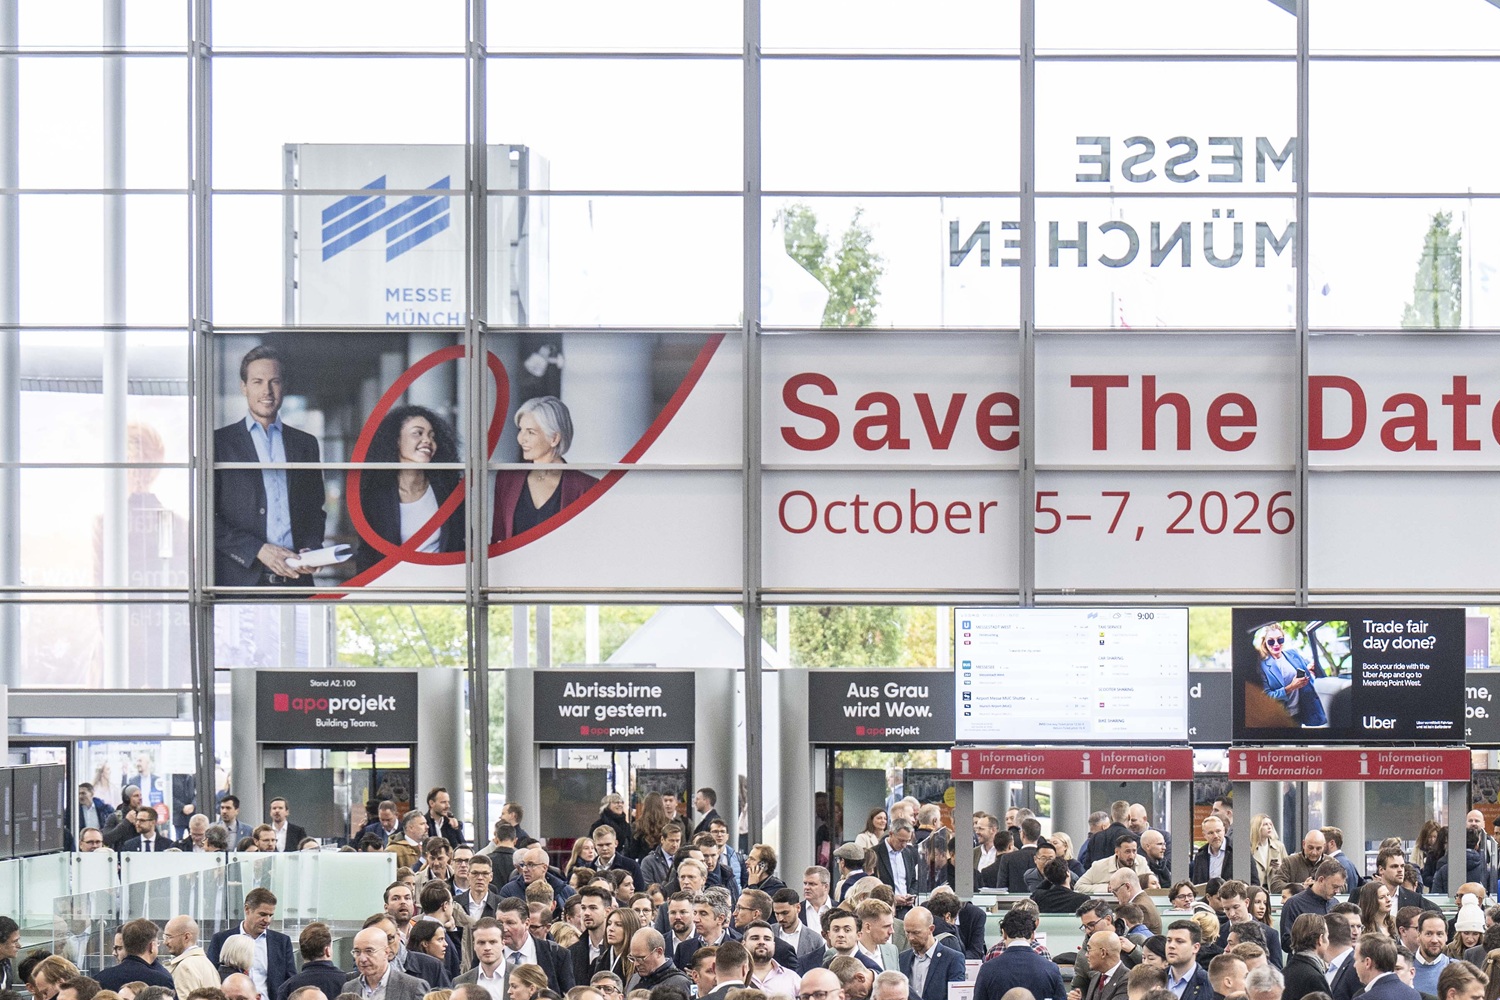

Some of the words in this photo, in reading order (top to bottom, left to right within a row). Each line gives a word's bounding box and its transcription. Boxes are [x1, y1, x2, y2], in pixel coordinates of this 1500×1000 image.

[386, 288, 452, 302] MESSE
[386, 308, 473, 325] MÜNCH
[780, 372, 1021, 452] Save
[1070, 375, 1258, 452] The
[778, 489, 998, 536] October
[1167, 490, 1296, 536] 2026
[1137, 612, 1155, 620] 9:00
[1362, 620, 1404, 633] Trade
[1406, 619, 1429, 633] fair
[1362, 636, 1390, 652] day
[1391, 636, 1437, 650] done?
[1378, 671, 1393, 680] App
[1405, 672, 1415, 680] go
[310, 679, 329, 687] Stand
[330, 679, 357, 687] A2.100
[1362, 679, 1388, 688] Meeting
[1388, 679, 1405, 687] Point
[1404, 679, 1422, 687] West.
[563, 682, 662, 698] Abrissbirne
[846, 682, 879, 698] Aus
[883, 682, 929, 698] Grau
[291, 693, 396, 715] apoprojekt
[842, 702, 880, 718] wird
[884, 701, 933, 718] Wow.
[558, 705, 591, 717] war
[594, 703, 668, 721] gestern.
[315, 718, 349, 729] Building
[349, 718, 379, 728] Teams.
[1362, 715, 1397, 729] Uber
[590, 725, 645, 736] apoprojekt
[866, 725, 920, 737] apoprojekt
[980, 752, 1045, 762] Information
[1101, 752, 1166, 762] Information
[1257, 752, 1323, 762] Information
[1378, 752, 1444, 762] Information
[980, 765, 1045, 775] Information
[1101, 765, 1167, 775] Information
[1257, 765, 1323, 775] Information
[1378, 765, 1444, 775] Information
